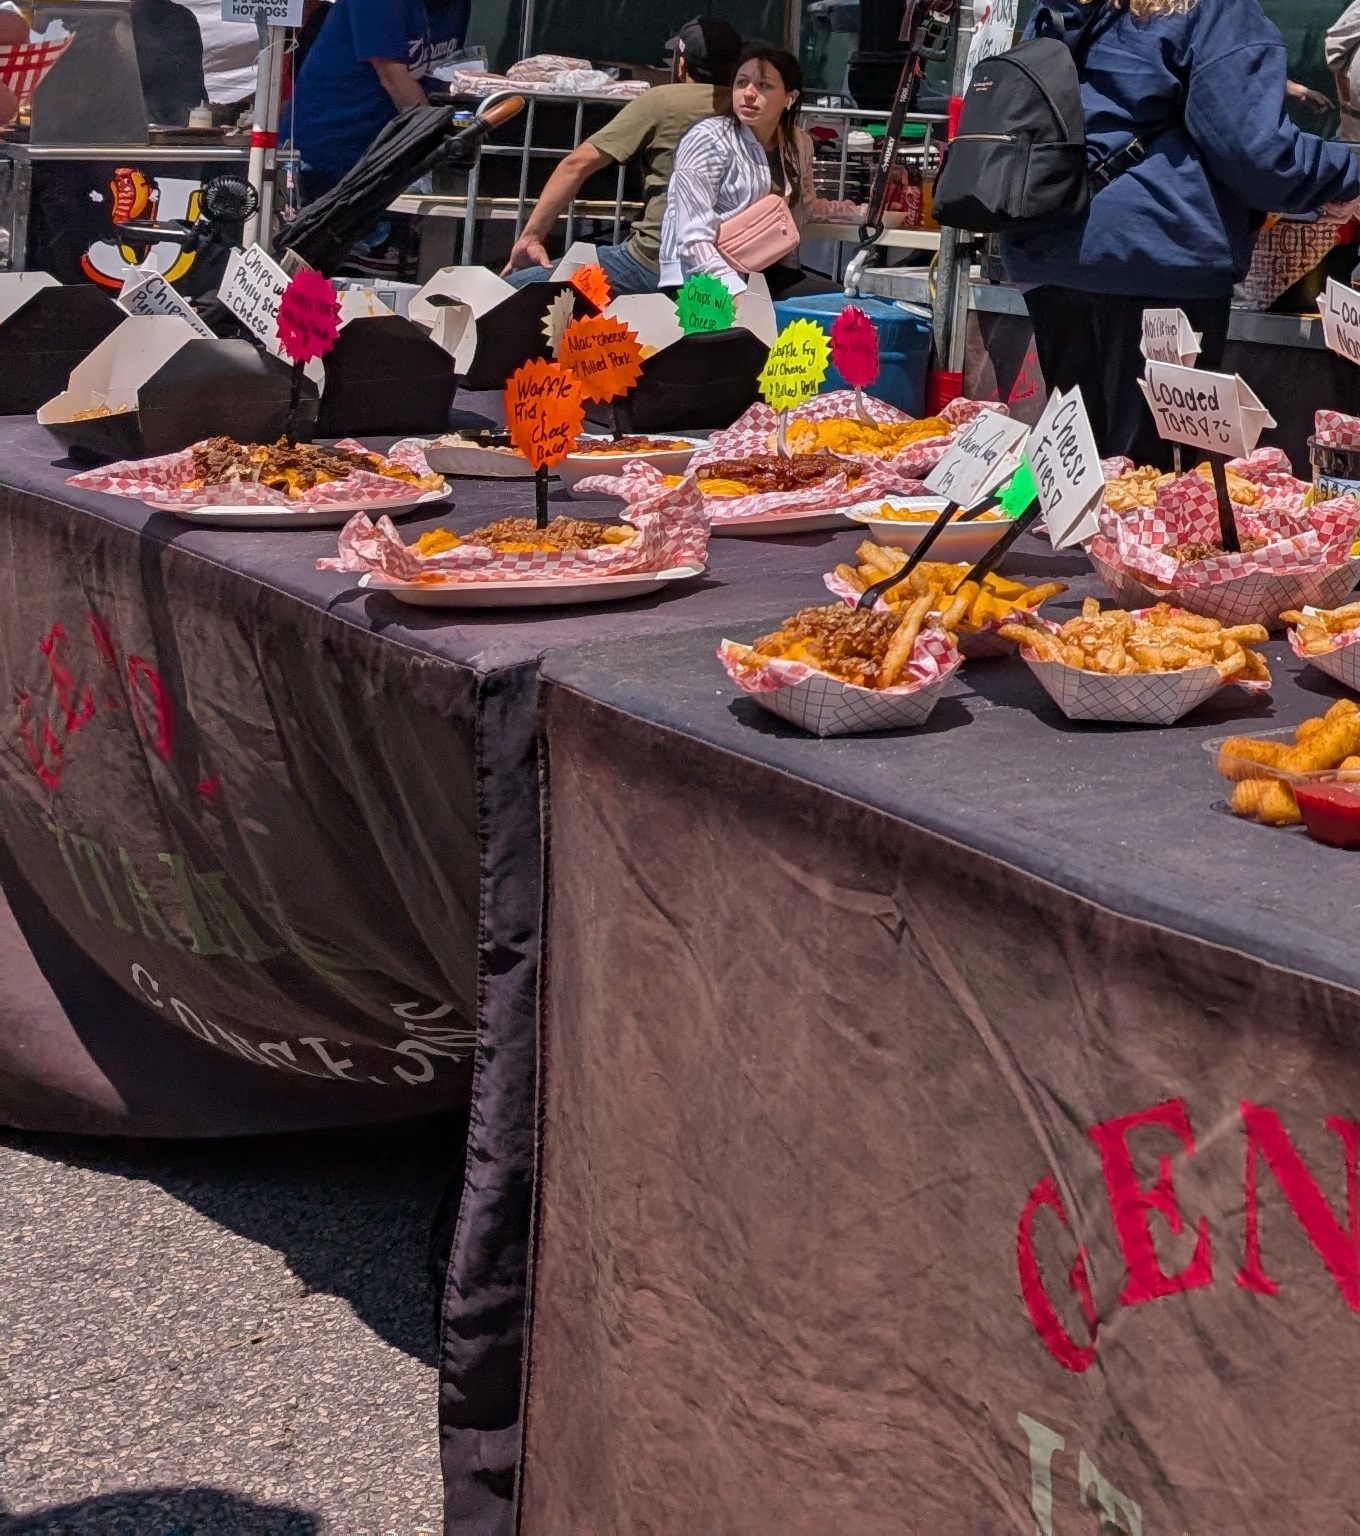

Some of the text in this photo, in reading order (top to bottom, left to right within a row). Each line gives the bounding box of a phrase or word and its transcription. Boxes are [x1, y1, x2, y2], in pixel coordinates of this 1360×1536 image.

[232, 5, 254, 15] HOT
[244, 249, 273, 287] Chips
[234, 266, 261, 312] Philly
[687, 288, 712, 308] Chips
[233, 297, 269, 335] Cheese
[689, 315, 717, 331] Cheese
[517, 375, 572, 399] Waffle
[1150, 368, 1219, 412] Loaded
[1052, 400, 1086, 485] Cheese
